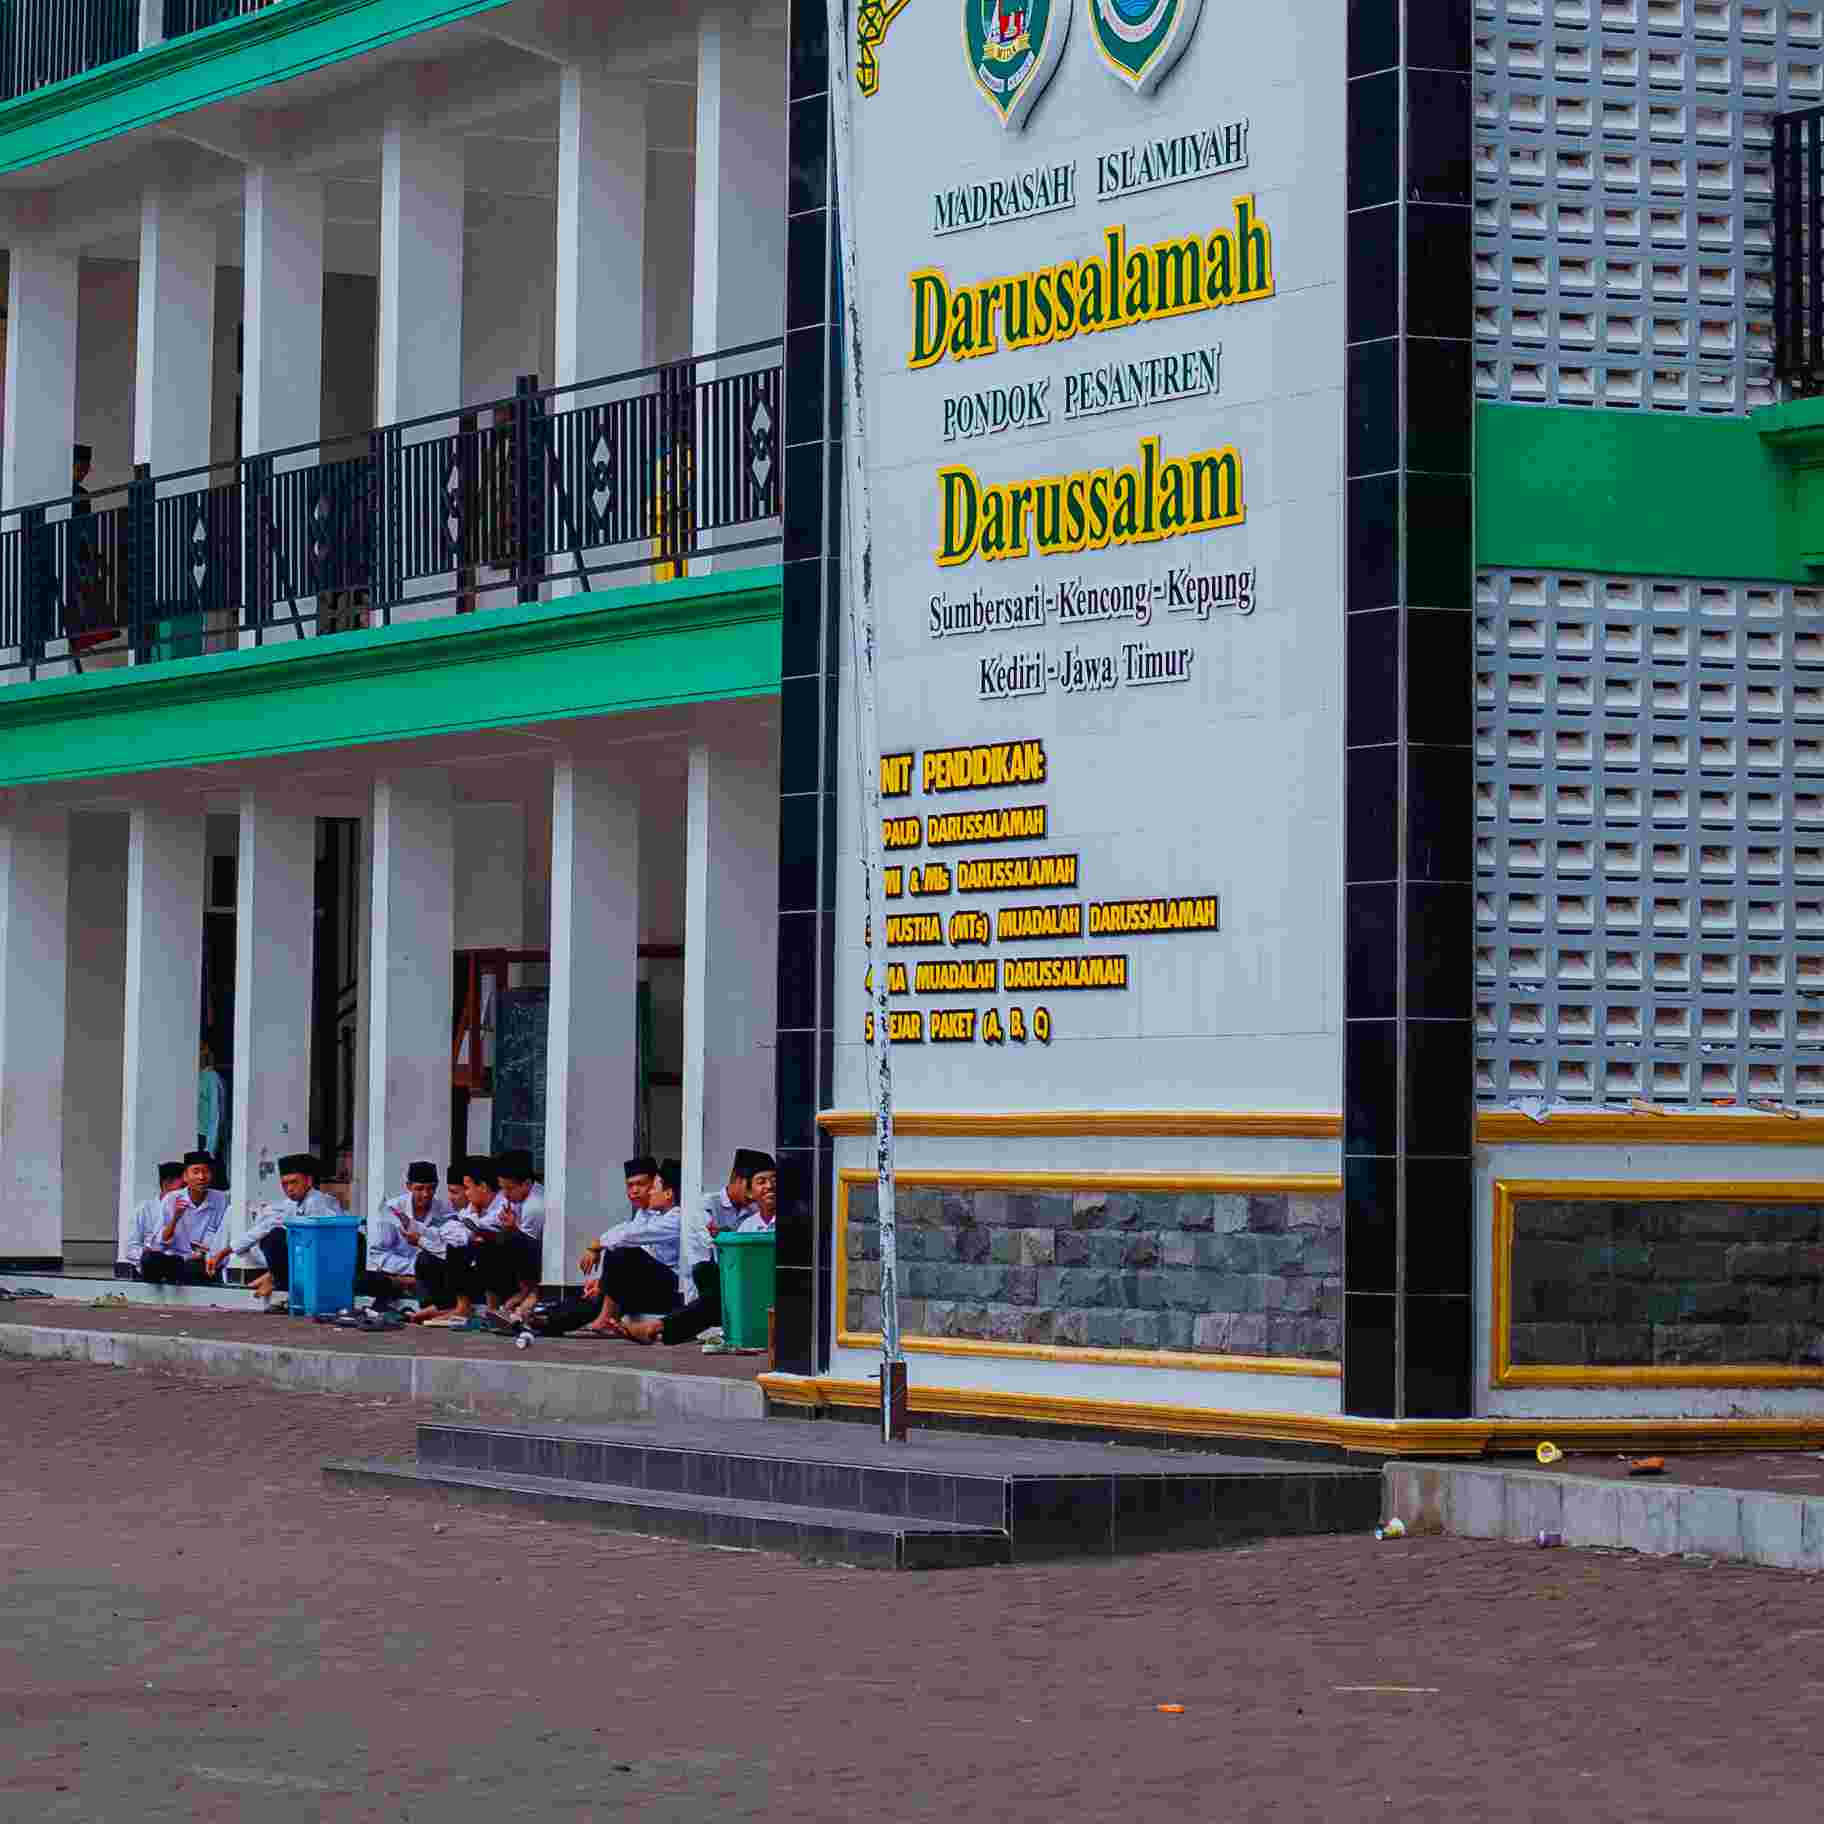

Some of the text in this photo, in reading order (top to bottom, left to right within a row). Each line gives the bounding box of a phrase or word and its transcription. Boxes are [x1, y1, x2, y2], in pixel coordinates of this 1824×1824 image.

[933, 120, 1247, 234] MADRASAH ISLAMIYAH
[909, 194, 1275, 370] Darussalamah
[943, 346, 1219, 439] PONDOK PESANTREN
[936, 435, 1247, 567] Darussalam
[1123, 643, 1191, 683] Timur
[880, 740, 1046, 796] NIT PENDIDIKAN:
[882, 806, 1046, 848] PAUD DARUSSALAMAH
[958, 854, 1077, 892] DARUSSALAMAH
[950, 911, 990, 946] (MTs)
[998, 905, 1082, 940] MUADALAH
[1089, 896, 1218, 935] DARUSSALAMAH
[916, 960, 996, 993] MUADALAH
[1005, 954, 1128, 990] DARUSSALAMAH
[890, 1011, 923, 1043] EJAR
[931, 1009, 976, 1041] PAKET
